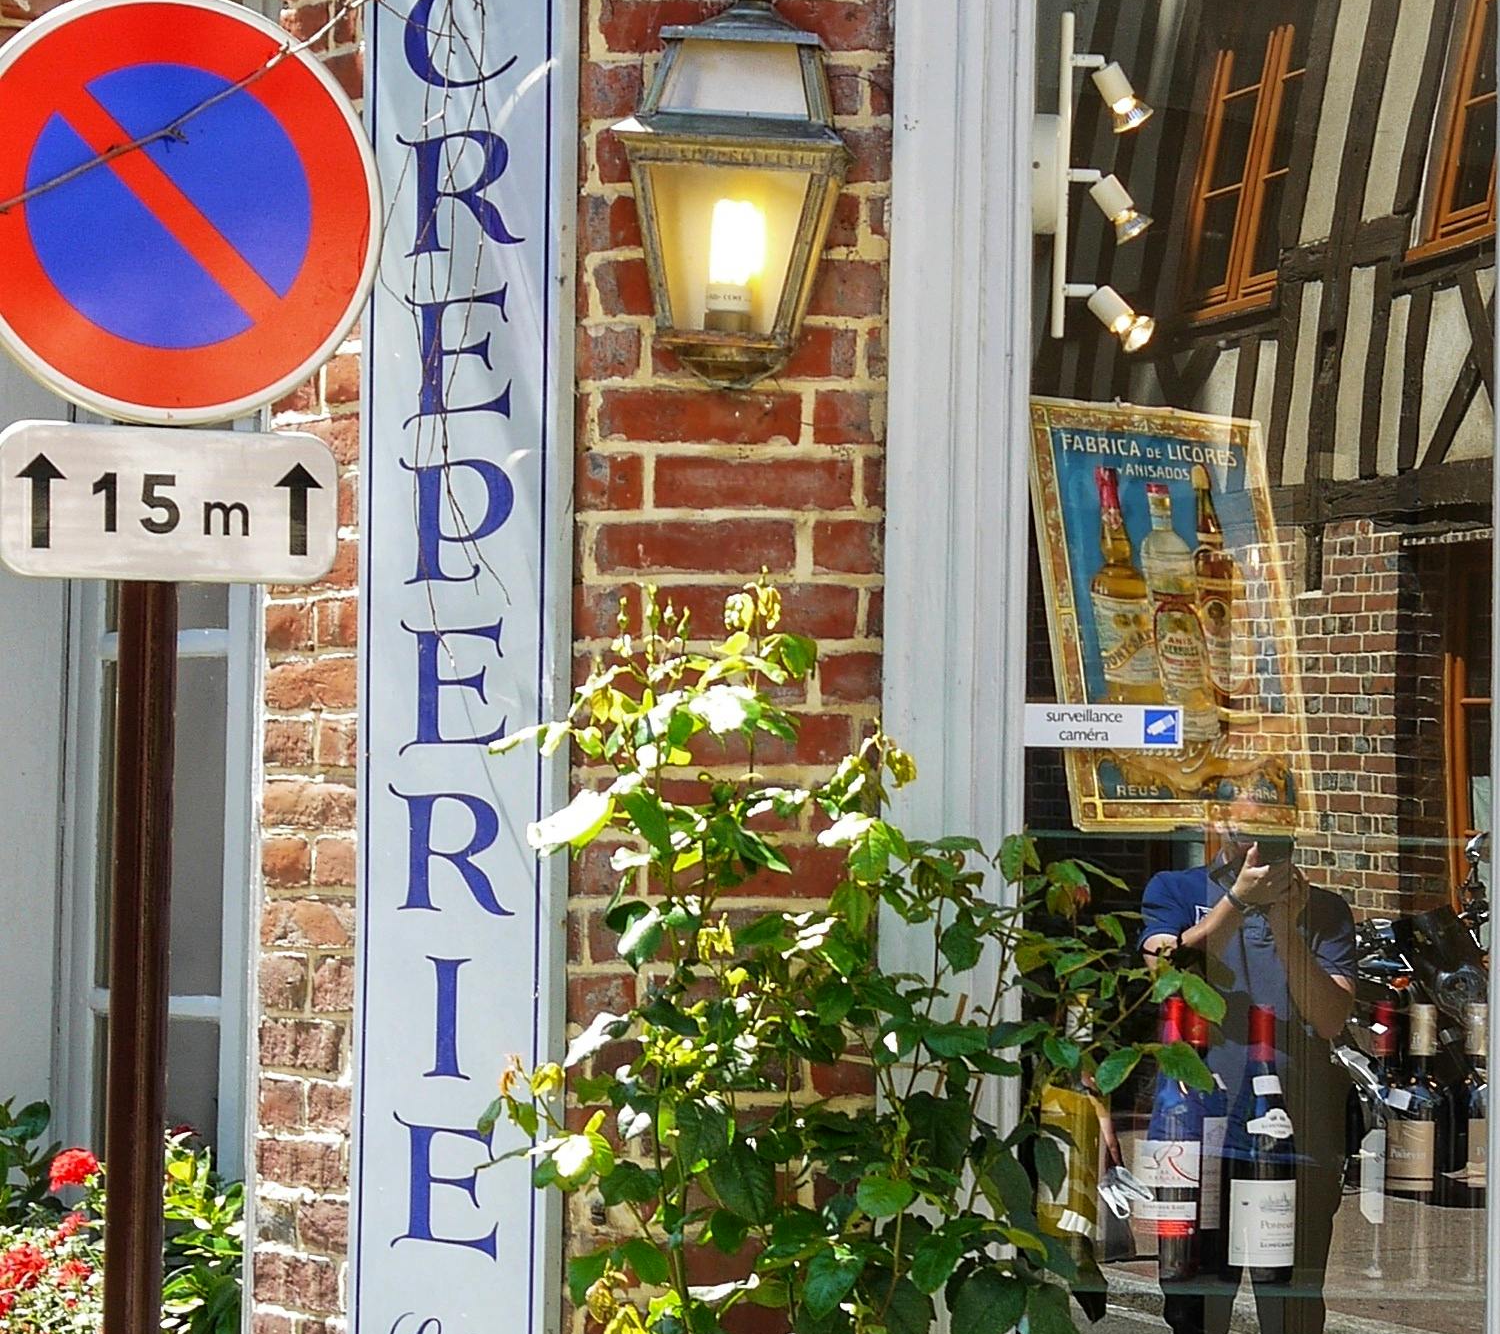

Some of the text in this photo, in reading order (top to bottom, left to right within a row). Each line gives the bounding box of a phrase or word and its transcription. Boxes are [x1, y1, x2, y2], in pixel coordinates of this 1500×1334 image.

[1062, 433, 1238, 467] FABRICA DE LICORES
[1125, 463, 1190, 481] ANISADOS
[92, 472, 250, 536] 15 m
[1046, 709, 1123, 723] surveillance
[1059, 728, 1109, 742] caméra
[1116, 784, 1160, 797] REUS
